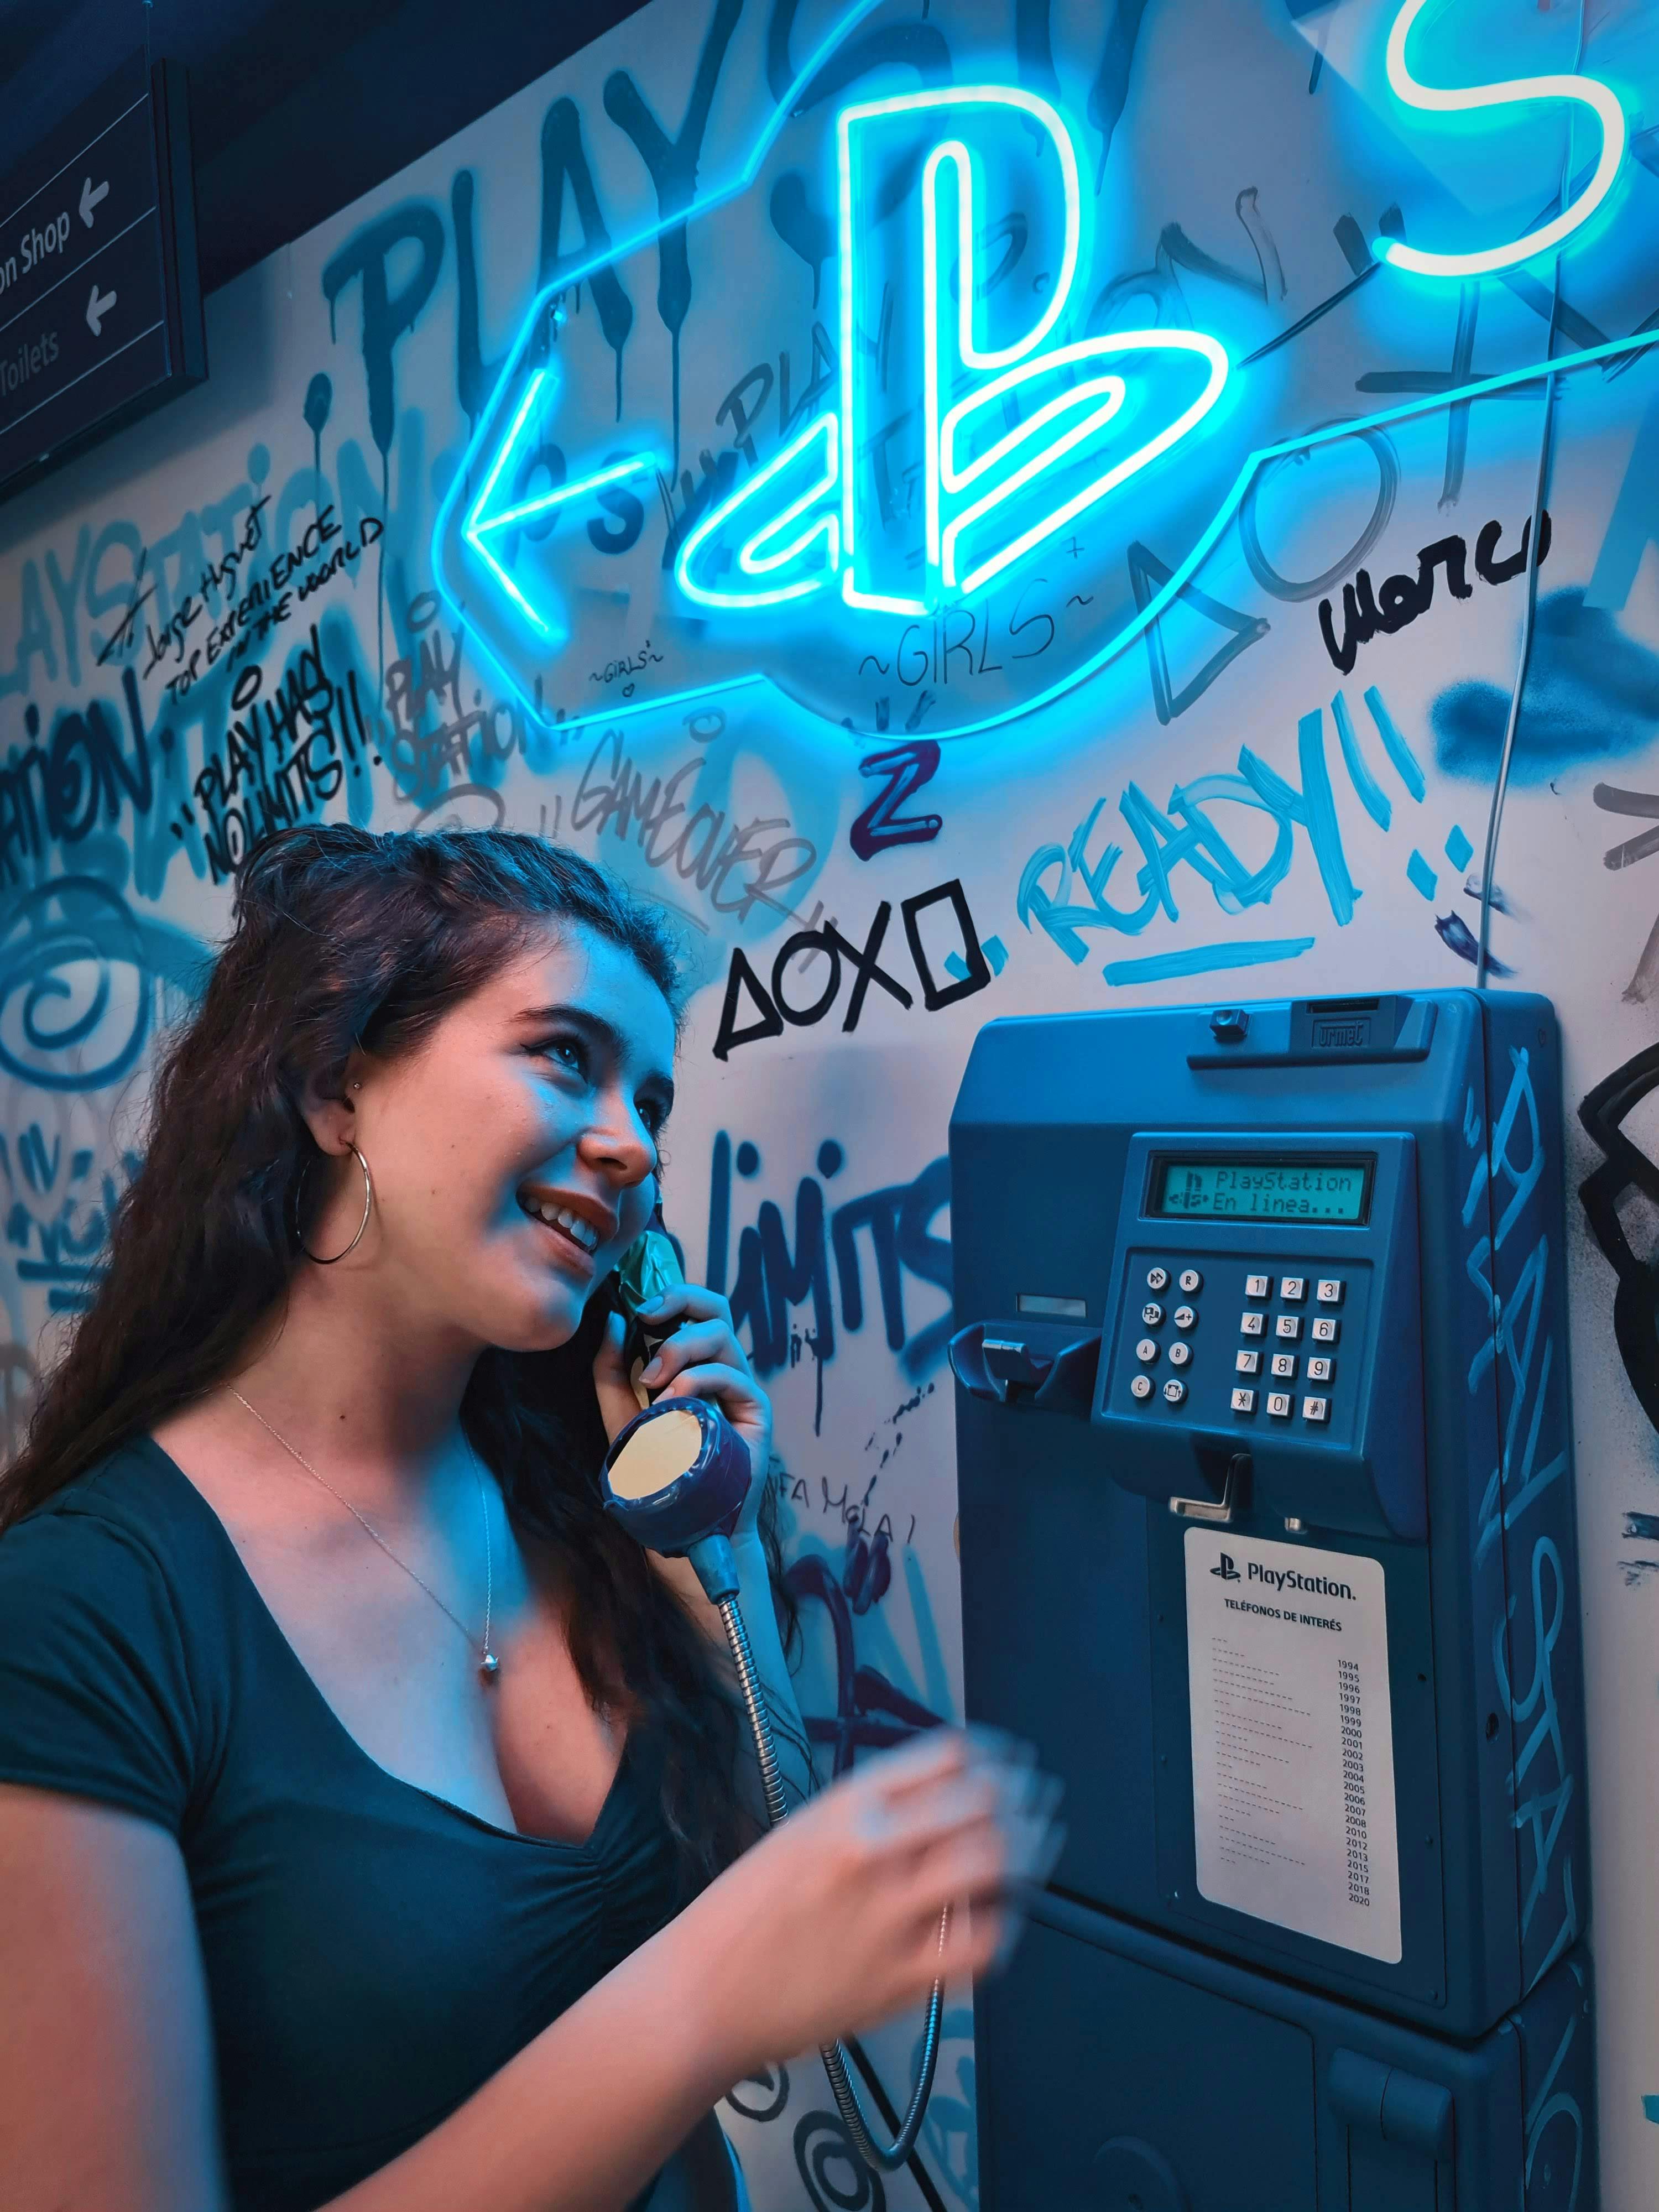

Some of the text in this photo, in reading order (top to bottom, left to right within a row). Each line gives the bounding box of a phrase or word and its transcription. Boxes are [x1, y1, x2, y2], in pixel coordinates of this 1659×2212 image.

[21, 211, 70, 274] Shop
[0, 331, 59, 397] Toilets
[1217, 1171, 1352, 1192] PlayStation
[1213, 1193, 1237, 1212] En
[1254, 1279, 1333, 1298] 1 2 3
[1247, 1317, 1328, 1337] 4 5 6
[1142, 1345, 1181, 1358] A B
[1243, 1354, 1323, 1376] 7 8 9
[1138, 1381, 1143, 1391] C
[1274, 1396, 1283, 1411] 0
[1224, 1598, 1343, 1631] TELÉFONOS DE INTERÉS
[1338, 1660, 1359, 1671] 1994
[1339, 1671, 1359, 1682] 1995
[1339, 1682, 1360, 1693] 1996
[1339, 1693, 1360, 1704] 1997
[1340, 1704, 1361, 1715] 1998
[1340, 1715, 1361, 1727] 1999
[1341, 1726, 1362, 1738] 2000
[1342, 1737, 1363, 1749] 2001
[1342, 1748, 1363, 1761] 2002
[1343, 1759, 1364, 1772] 2003
[1343, 1771, 1364, 1783] 2004
[1344, 1781, 1365, 1794] 2005
[1344, 1792, 1365, 1805] 2006
[1345, 1804, 1366, 1816] 2007
[1345, 1815, 1366, 1828] 2008
[1346, 1826, 1366, 1839] 2010
[1347, 1838, 1367, 1850] 2012
[1347, 1849, 1368, 1861] 2013
[1348, 1860, 1369, 1872] 2015
[1348, 1871, 1369, 1884] 2017
[1348, 1882, 1369, 1895] 2018
[1349, 1893, 1370, 1906] 2020
